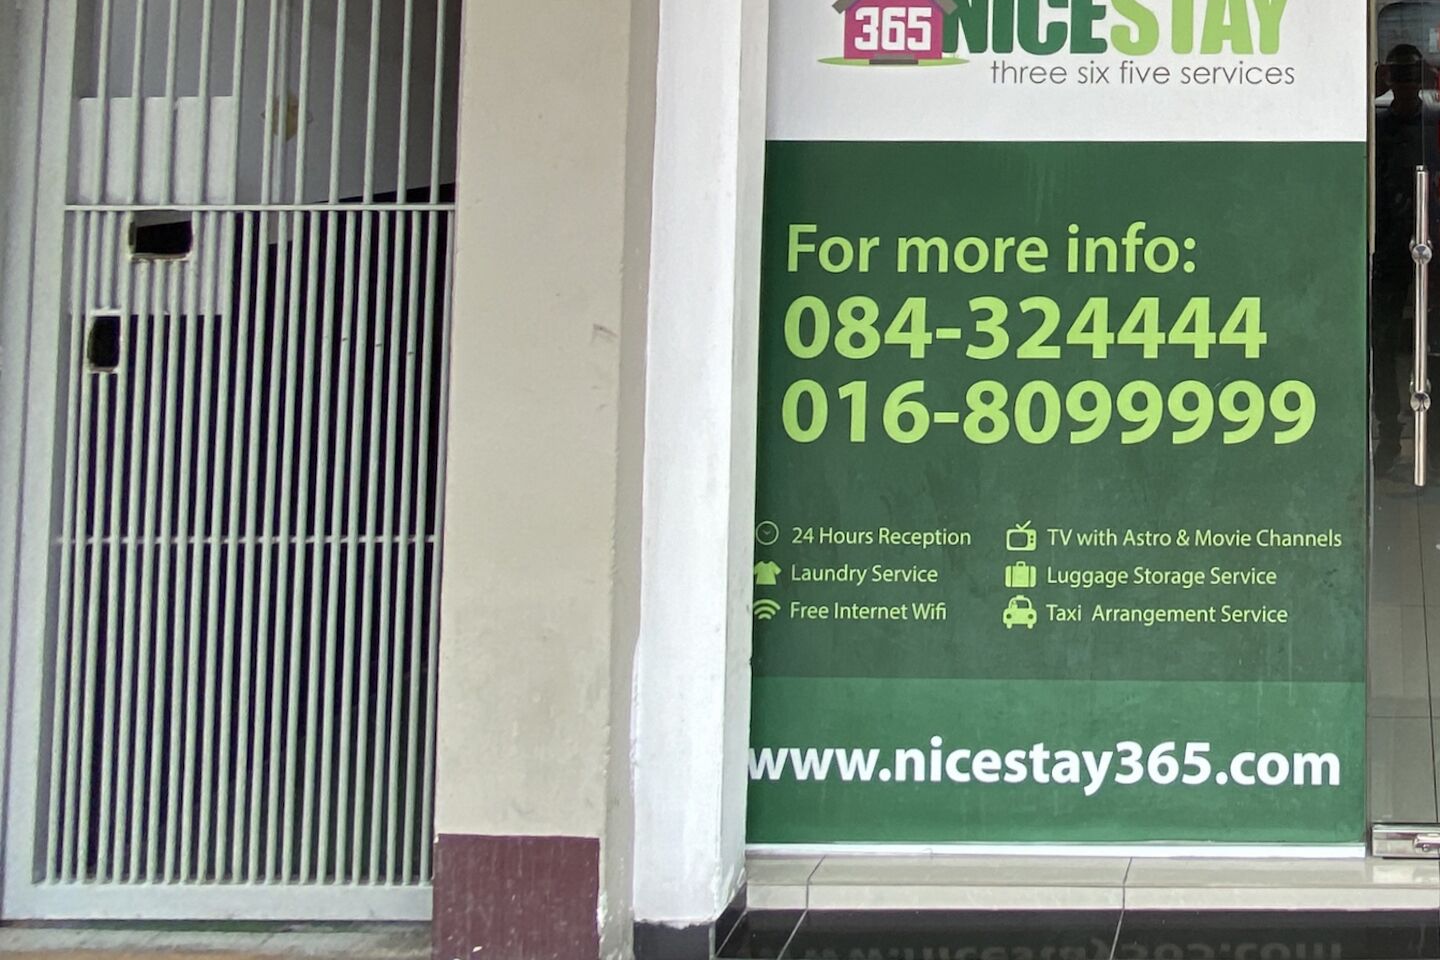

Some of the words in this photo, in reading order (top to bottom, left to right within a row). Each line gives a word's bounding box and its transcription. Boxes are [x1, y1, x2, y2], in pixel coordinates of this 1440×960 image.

[854, 6, 932, 51] 365
[990, 60, 1067, 85] three
[1077, 60, 1110, 85] six
[1119, 60, 1171, 85] five
[1180, 60, 1295, 86] services
[787, 224, 880, 274] For
[897, 235, 1048, 274] more
[1067, 222, 1196, 274] info:
[784, 296, 1267, 359] 084-324444
[782, 380, 1316, 444] 016-8099999
[792, 527, 814, 545] 24
[820, 528, 874, 545] Hours
[878, 527, 972, 550] Reception
[1047, 529, 1073, 546] TV
[1078, 528, 1118, 546] with
[1122, 530, 1173, 547] Astro
[1178, 530, 1190, 547] &
[1196, 529, 1251, 548] Movie
[1256, 529, 1342, 548] Channels
[792, 564, 866, 586] Laundry
[872, 566, 938, 583] Service
[1047, 567, 1128, 590] Luggage
[1134, 567, 1204, 590] Storage
[1210, 568, 1277, 585] Service
[790, 602, 830, 620] Free
[834, 602, 907, 620] Internet
[912, 602, 946, 620] Wifi
[1046, 604, 1082, 622] Taxi
[1092, 606, 1216, 626] Arrangement
[1220, 606, 1288, 624] Service
[747, 735, 1340, 796] www.nicestay365.com
